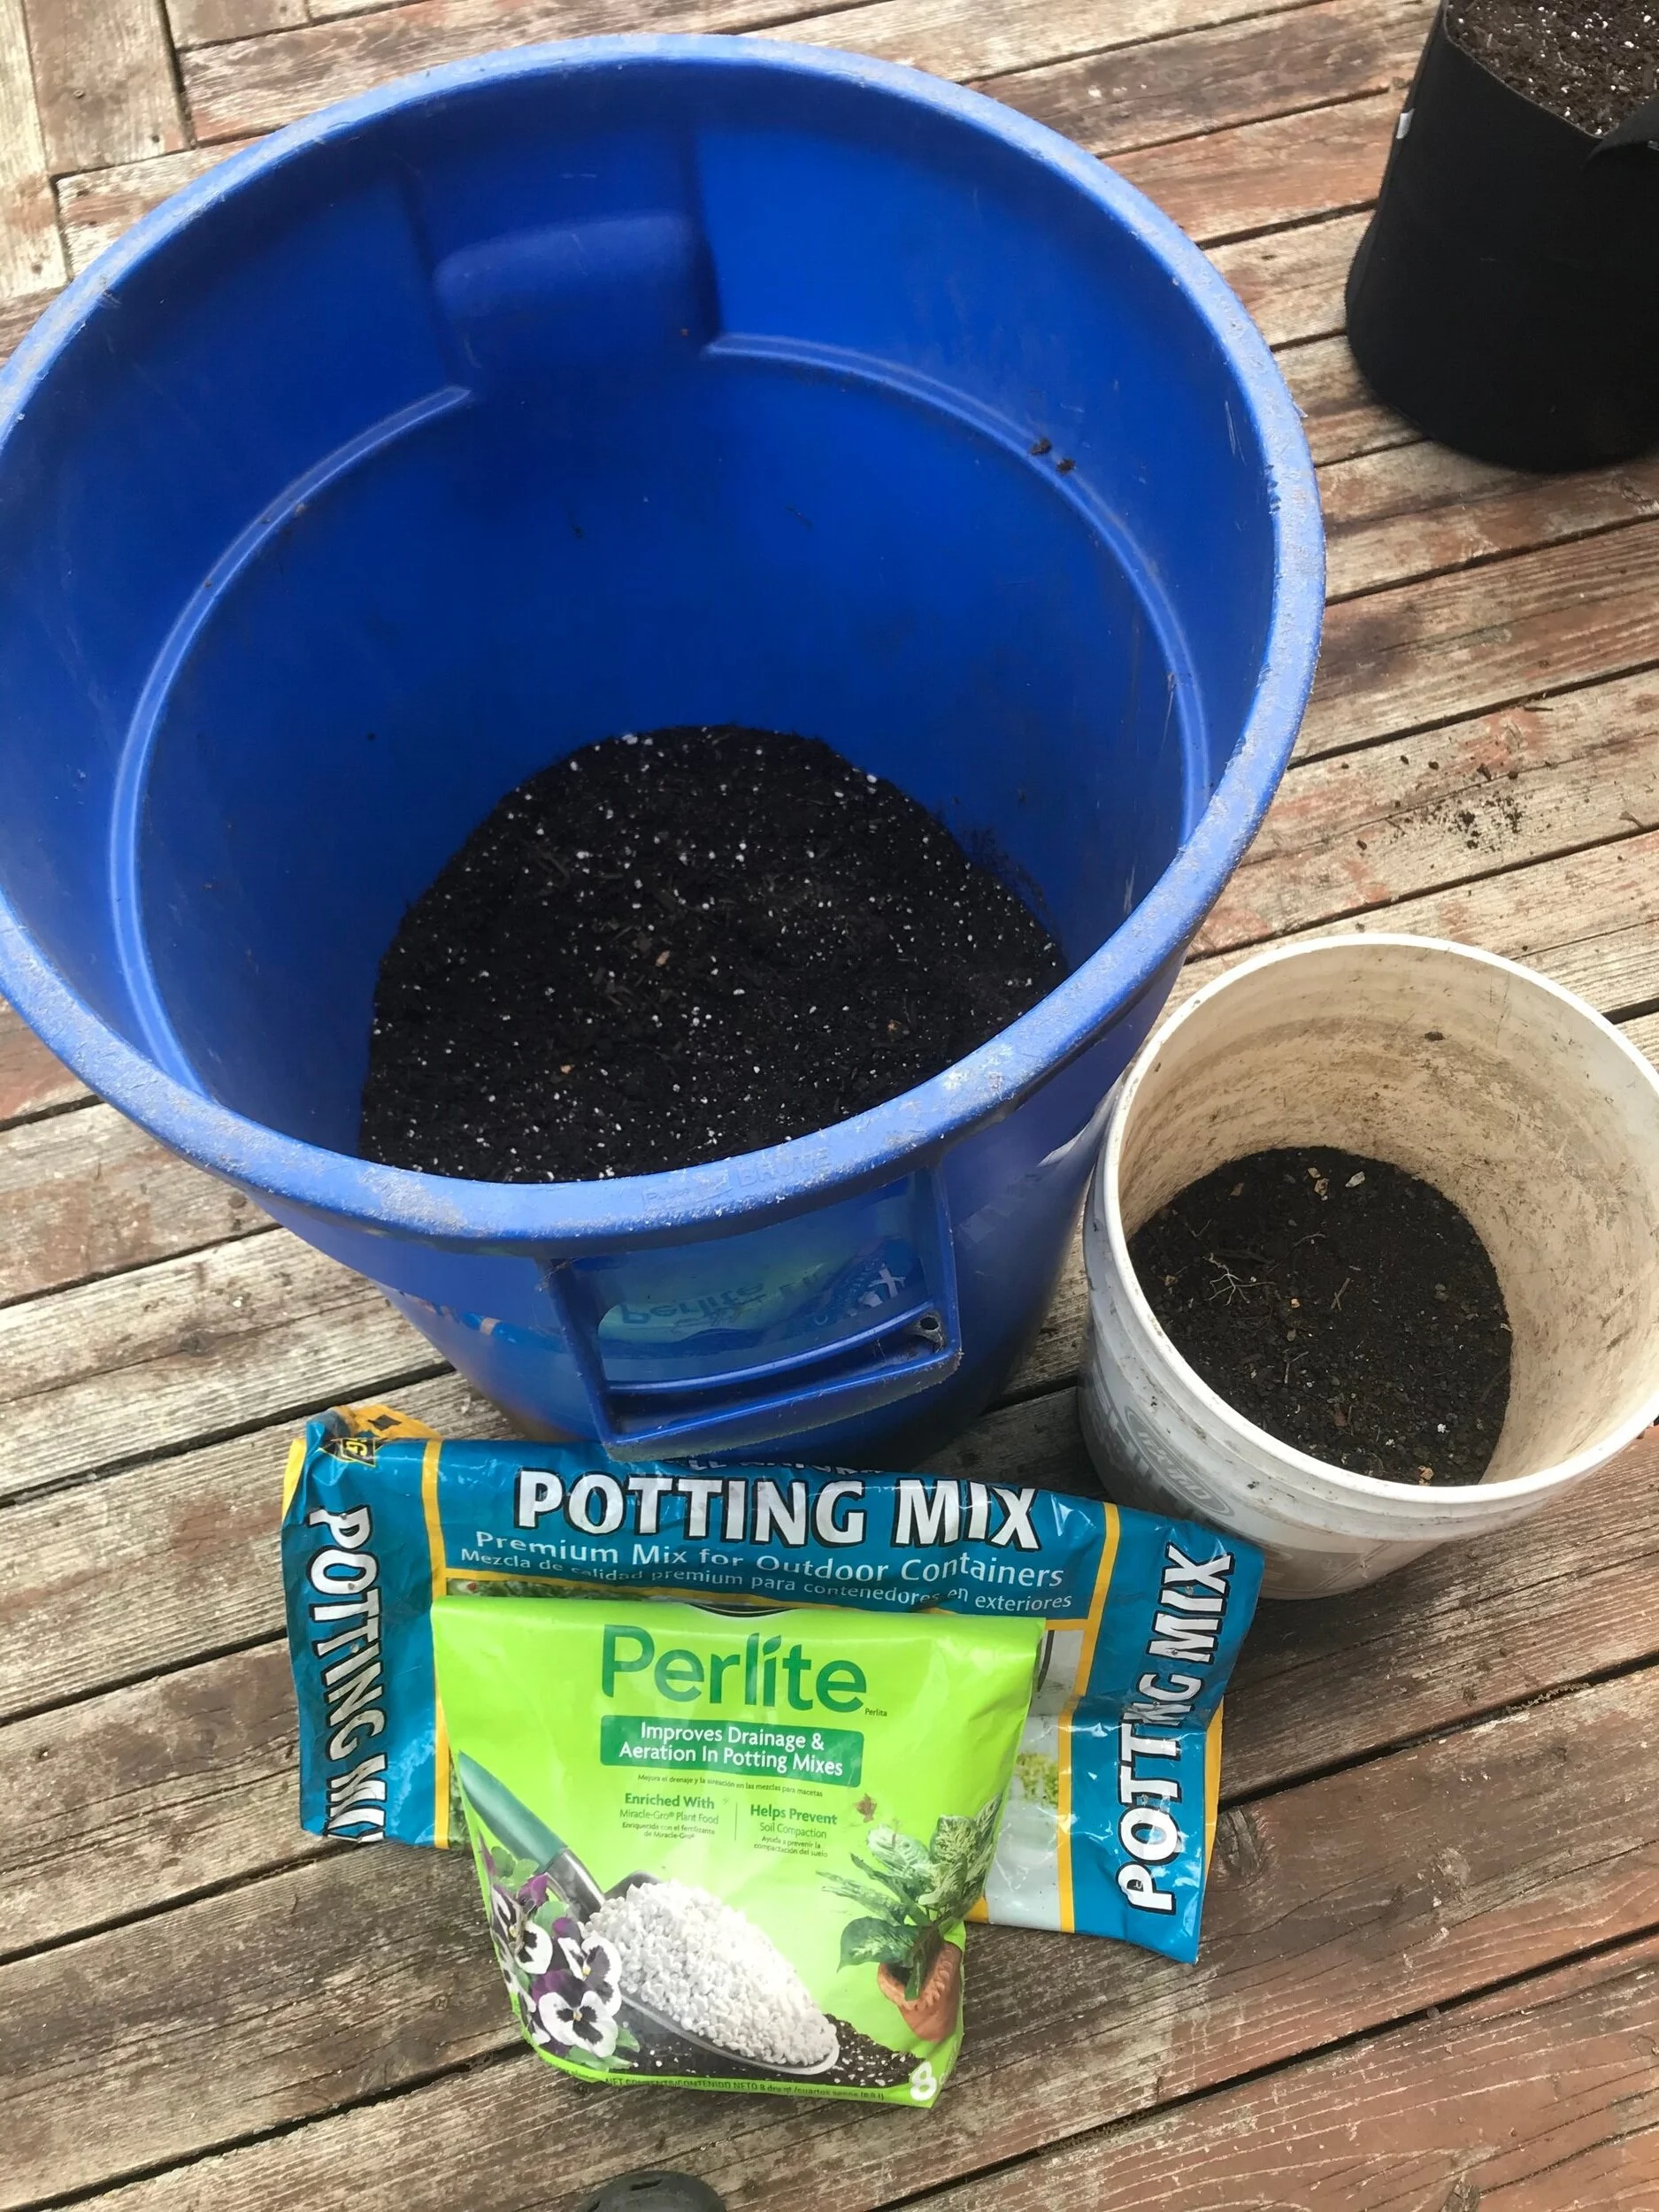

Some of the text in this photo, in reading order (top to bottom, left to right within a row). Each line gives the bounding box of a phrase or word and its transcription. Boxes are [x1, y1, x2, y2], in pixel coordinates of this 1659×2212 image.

[516, 1468, 1041, 1550] POTTING MIX
[476, 1531, 1064, 1587] Premium Mix for Outdoor Containers
[461, 1548, 1072, 1611] Mezcla de calidad premium para contenedores en exteriores
[1147, 1542, 1235, 1663] MIX
[306, 1505, 386, 1762] POTTING
[601, 1624, 867, 1713] Perlite
[864, 1707, 887, 1717] Perlita
[641, 1722, 825, 1753] Improves Drainage &
[618, 1741, 843, 1778] Aeration In Potting Mixes
[325, 1751, 388, 1844] MI
[625, 1793, 715, 1809] Enriched With
[668, 1776, 694, 1785] drenaje
[796, 1788, 823, 1797] macetas
[676, 1811, 696, 1822] Plant
[698, 1813, 719, 1824] Food
[750, 1804, 838, 1825] Helps Prevent
[759, 1822, 827, 1839] Soil Compaction
[787, 1839, 813, 1848] prevenir
[733, 2080, 758, 2090] NETO
[910, 2060, 938, 2101] 8
